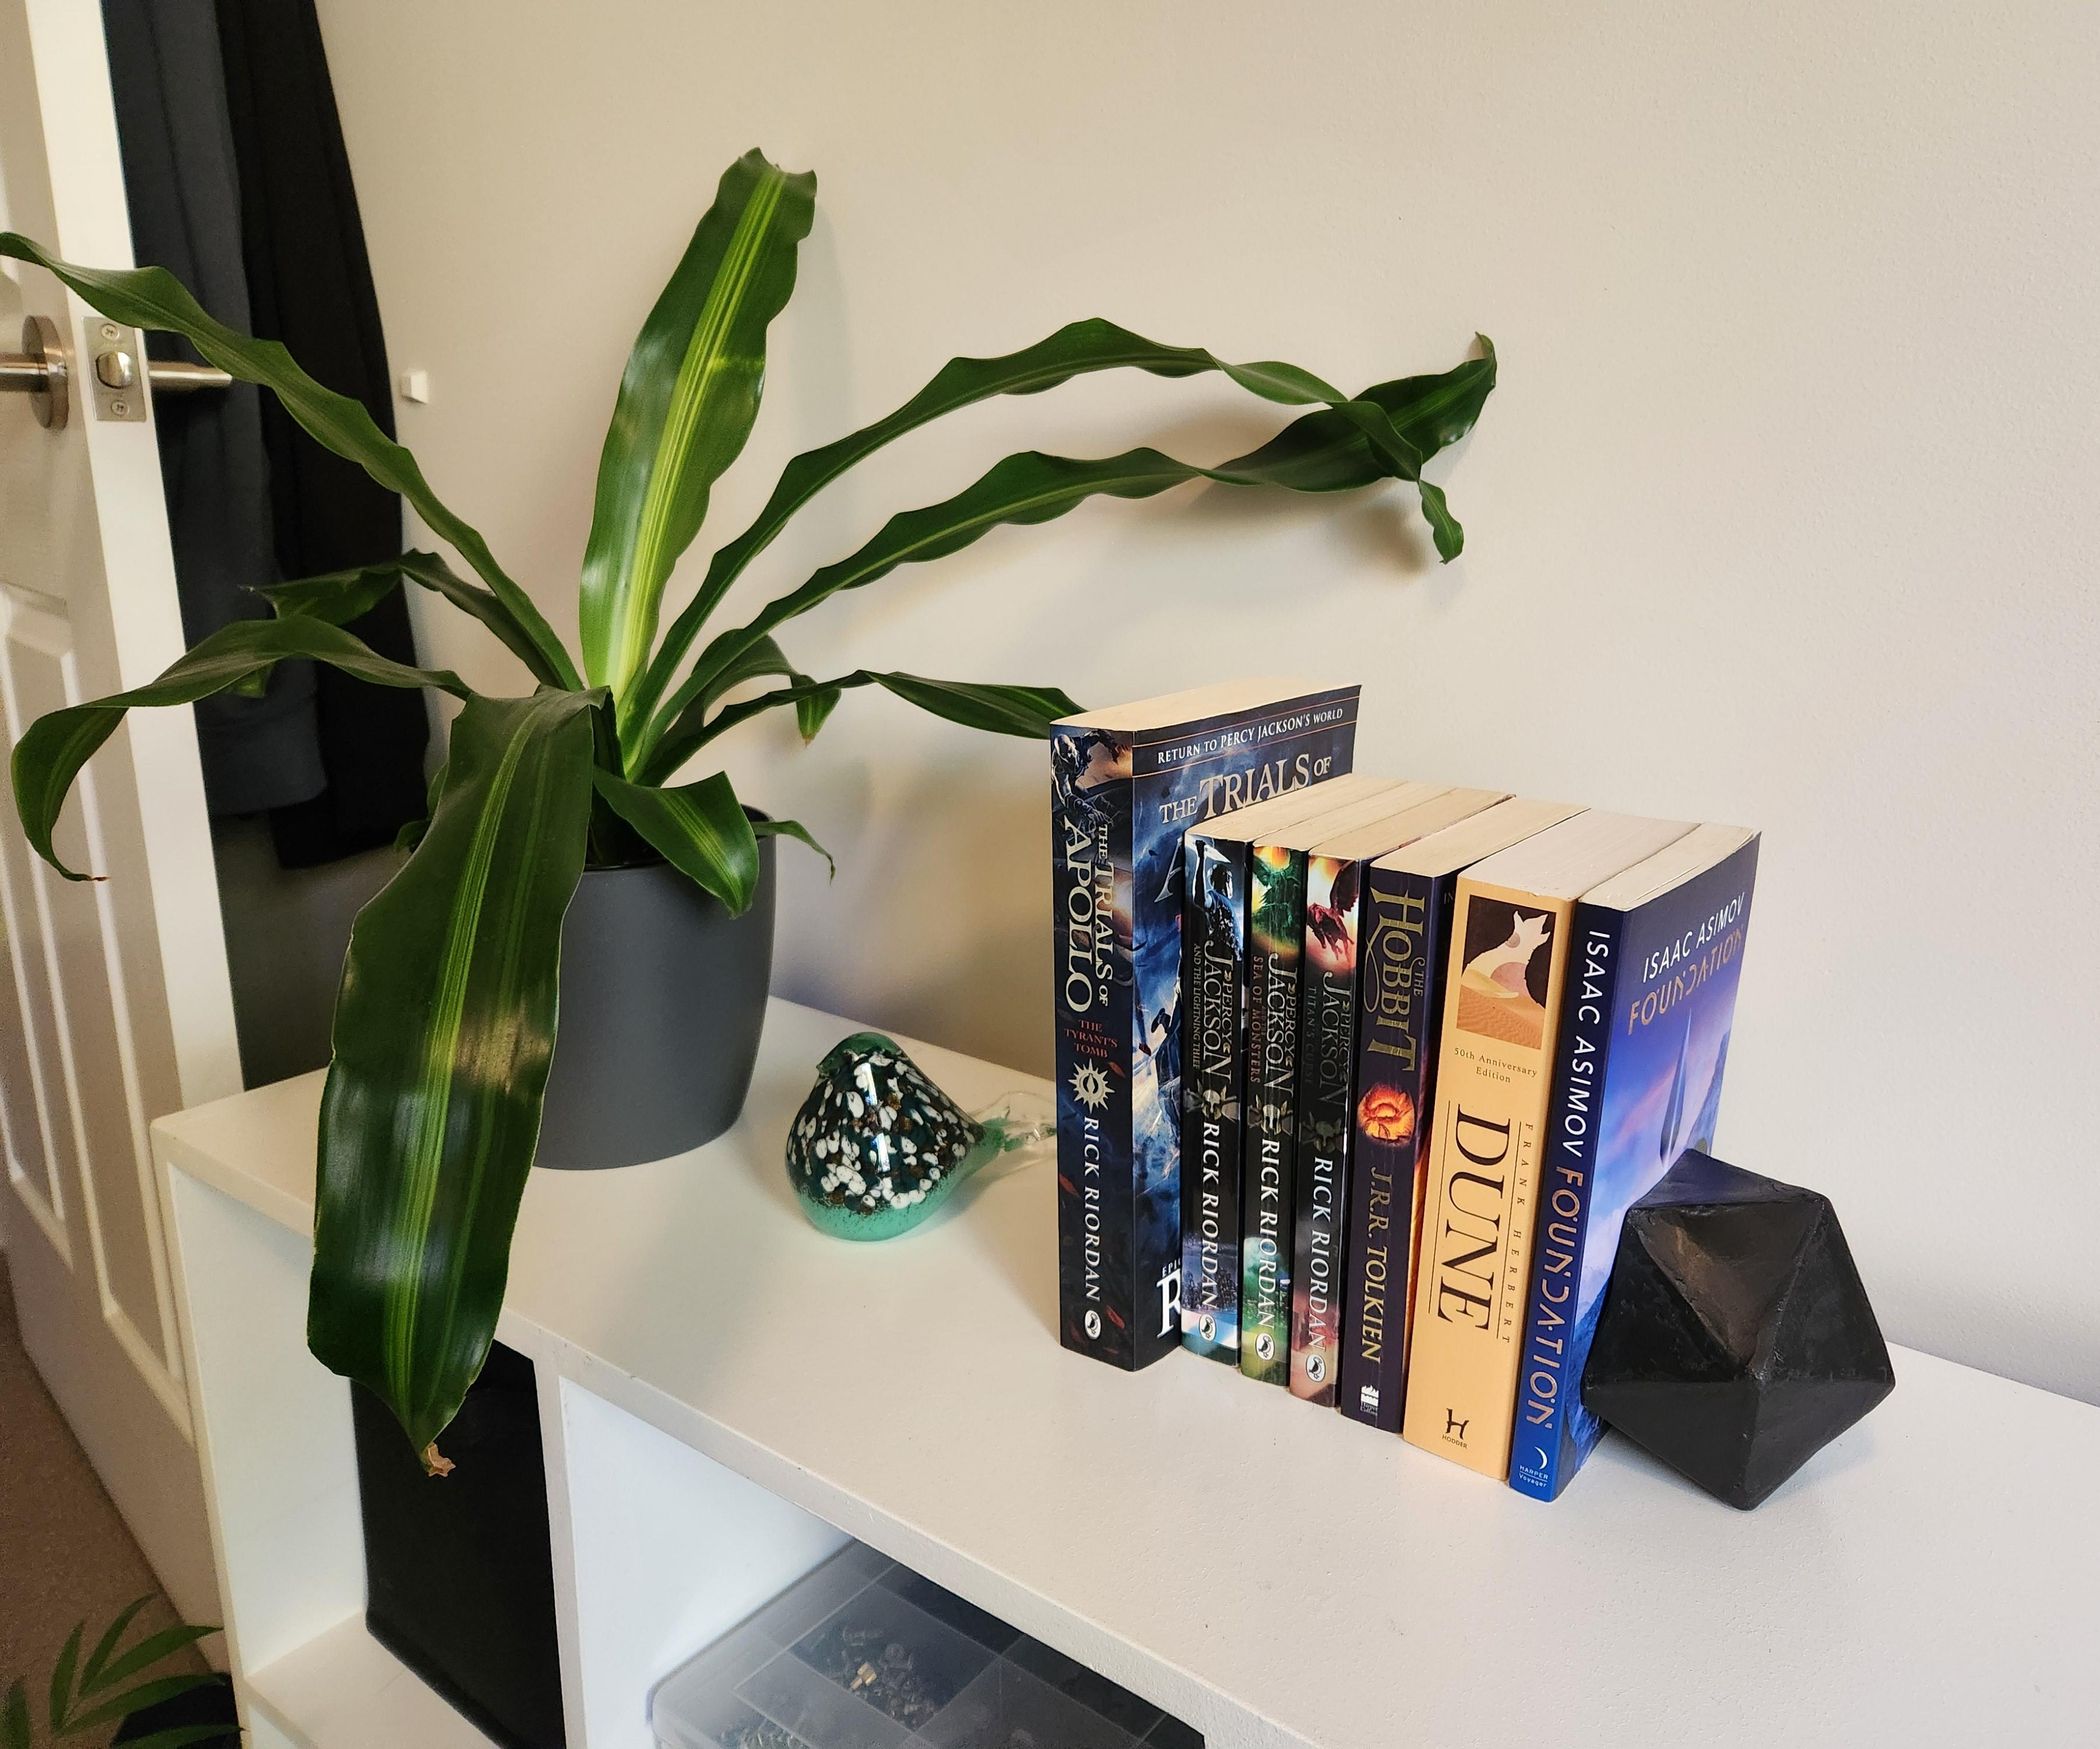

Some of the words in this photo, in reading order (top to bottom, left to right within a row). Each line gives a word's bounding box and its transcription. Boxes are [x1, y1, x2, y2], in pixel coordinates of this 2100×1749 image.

[1157, 743, 1200, 765] RETURN
[1203, 739, 1217, 752] TO
[1220, 728, 1255, 750] PERCY
[1257, 713, 1311, 742] JACKSON'S
[1313, 708, 1343, 723] WORLD
[1159, 795, 1198, 824] THE
[1200, 753, 1310, 822] TRIALS
[1313, 756, 1332, 777] OF
[1095, 824, 1108, 861] THE
[1063, 815, 1093, 1013] APOLLO
[1094, 861, 1115, 981] TRIALS
[1643, 931, 1693, 983] ISAAC
[1695, 892, 1745, 949] ASIMOV
[1193, 943, 1201, 965] AND
[1253, 955, 1264, 980] SEA
[1363, 887, 1426, 1072] HOBBIT
[1411, 957, 1426, 997] THE
[1578, 931, 1611, 1025] ISAAC
[1627, 926, 1744, 1036] FOUNDATION
[1078, 1019, 1103, 1033] THE
[1099, 984, 1108, 1006] OF
[1201, 940, 1234, 1085] JACKSON
[1222, 982, 1234, 1044] PERCY
[1252, 986, 1262, 1004] OF
[1263, 952, 1298, 1096] JACKSON
[1284, 996, 1296, 1058] PERCY
[1305, 986, 1317, 1038] TITAN'S
[1064, 1028, 1118, 1048] TYRANT'S
[1074, 1042, 1109, 1058] TOMB
[1192, 1042, 1200, 1069] THIEF
[1250, 1009, 1262, 1083] MONSTERS
[1319, 971, 1353, 1107] JACKSON
[1338, 1012, 1352, 1068] PERCY
[1454, 1047, 1475, 1061] 50th
[1478, 1054, 1538, 1078] Anniversary
[1476, 1067, 1511, 1084] Edition
[1562, 1035, 1596, 1158] ASIMOV
[1084, 1117, 1100, 1180] RICK
[1202, 1122, 1220, 1185] RICK
[1260, 1139, 1280, 1202] RICK
[1516, 1123, 1534, 1205] FRANK
[1312, 1156, 1333, 1223] RICK
[1367, 1167, 1393, 1238] J.R.R.
[1437, 1104, 1511, 1330] DUNE
[1084, 1186, 1101, 1301] RIORDAN
[1201, 1191, 1219, 1310] RIORDAN
[1257, 1211, 1278, 1330] RIORDAN
[1308, 1230, 1331, 1351] RIORDAN
[1361, 1246, 1387, 1364] TOLKIEN
[1502, 1230, 1522, 1344] HERBERT
[1526, 1166, 1582, 1429] FOUNDATION
[1441, 1434, 1468, 1449] HODDER
[1519, 1465, 1549, 1480] HARPER
[1518, 1473, 1547, 1488] Voyager
